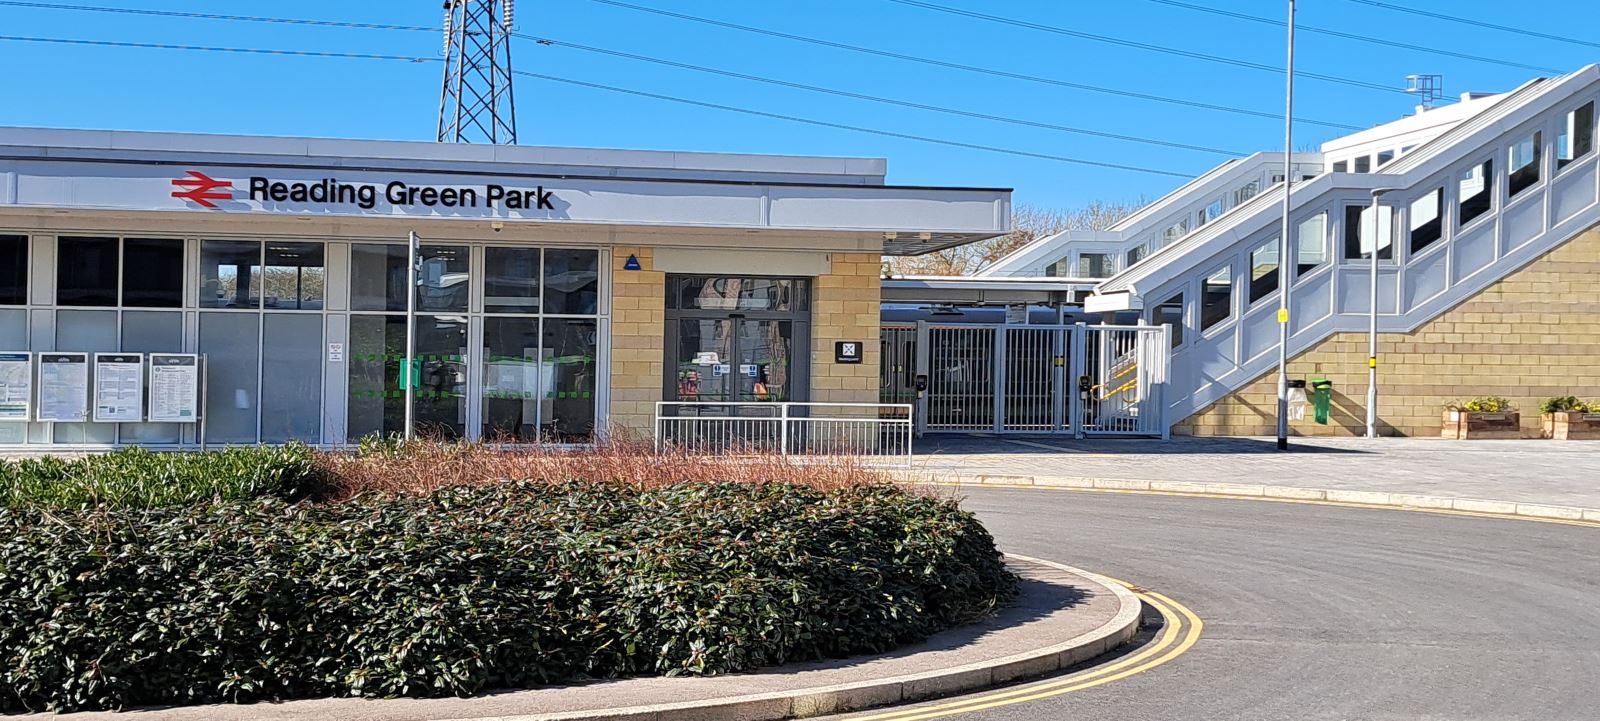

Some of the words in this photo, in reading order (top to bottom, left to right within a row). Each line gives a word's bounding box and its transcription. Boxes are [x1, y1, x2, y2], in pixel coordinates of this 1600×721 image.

[249, 176, 376, 209] Reading
[385, 180, 476, 208] Green
[486, 184, 555, 210] Park
